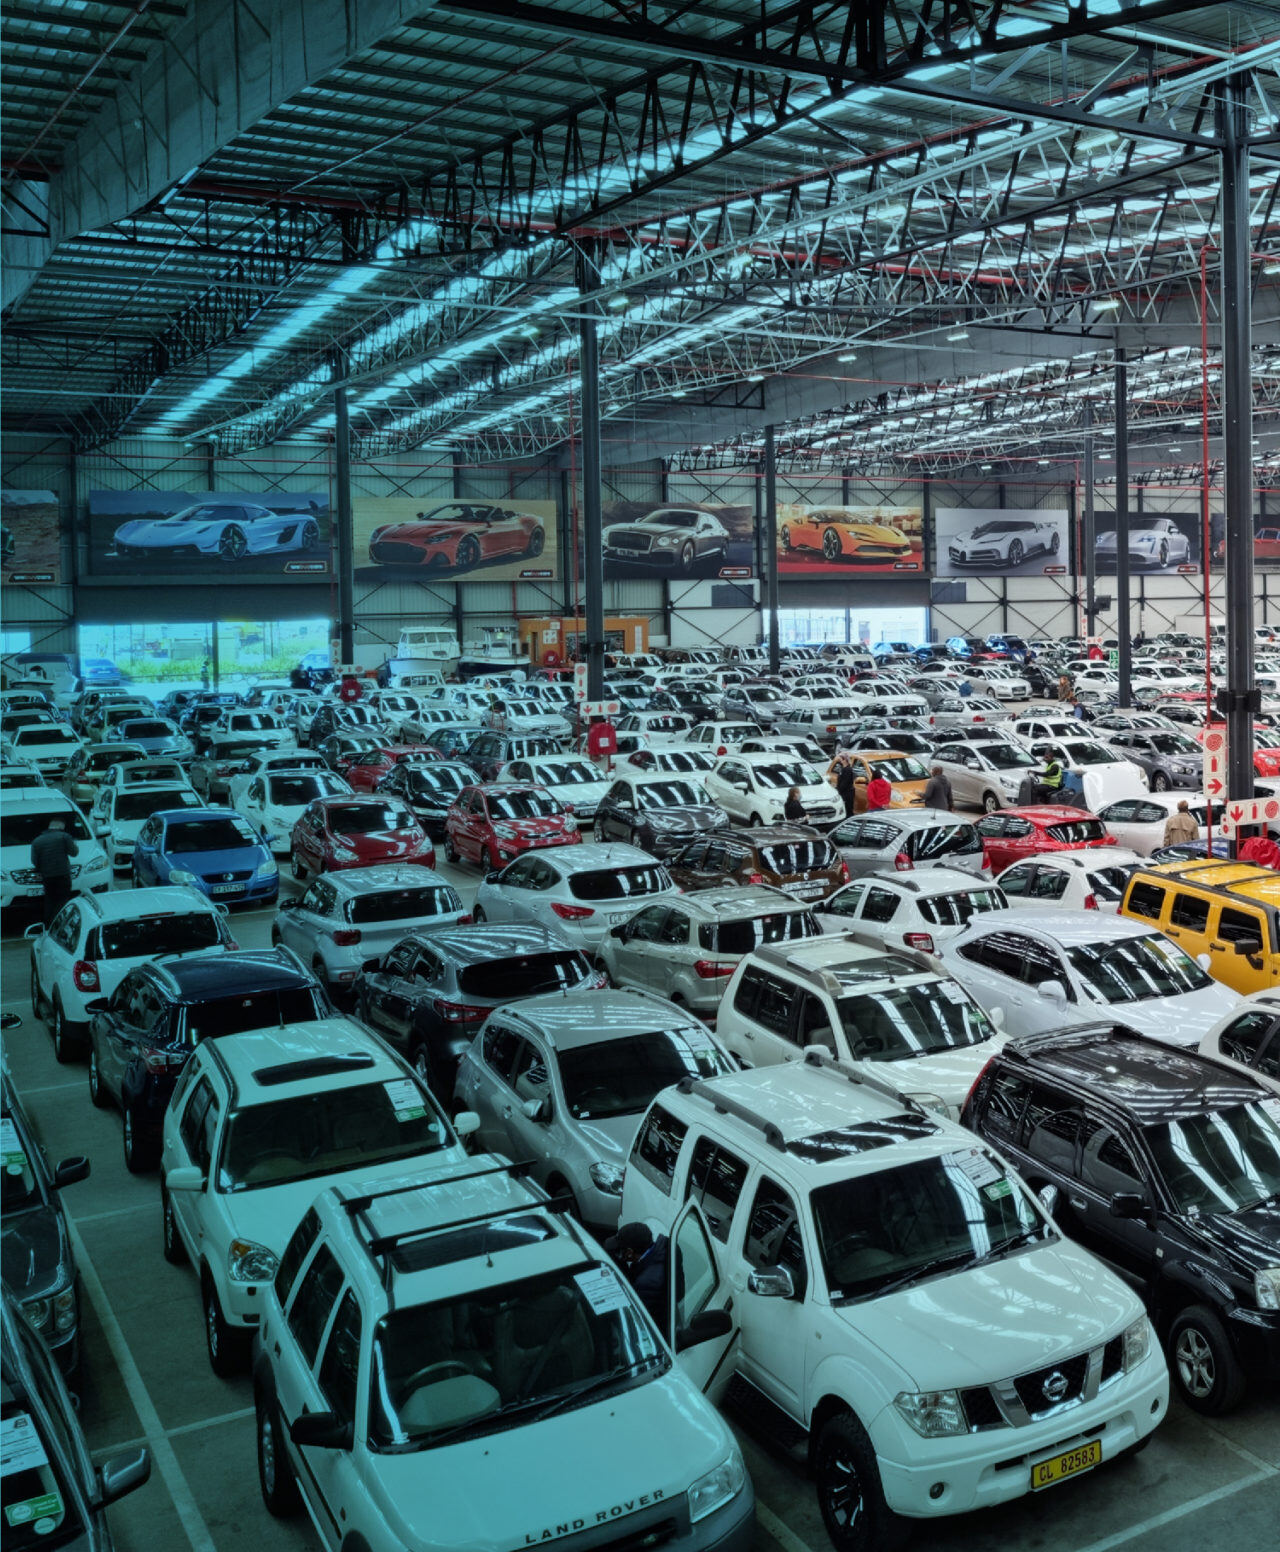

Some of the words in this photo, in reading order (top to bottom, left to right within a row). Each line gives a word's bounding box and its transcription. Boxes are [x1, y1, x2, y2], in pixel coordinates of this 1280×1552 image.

[1039, 1465, 1054, 1481] CL
[1061, 1446, 1095, 1474] 82583
[525, 1519, 585, 1544] LAND
[595, 1489, 665, 1522] ROVER
